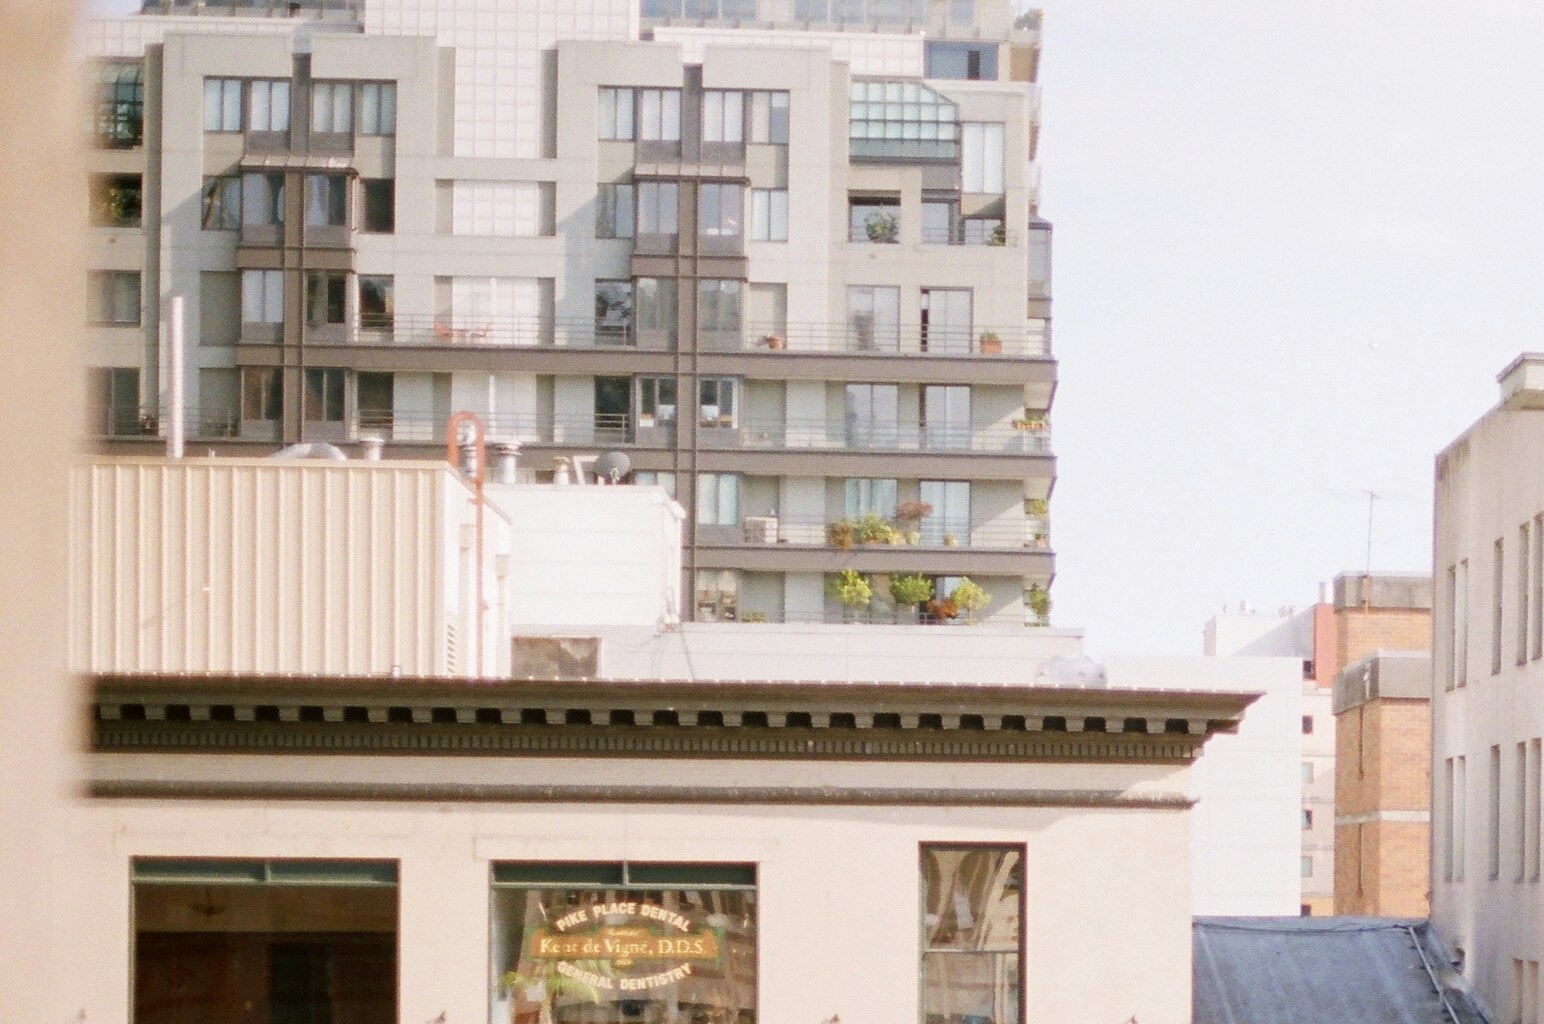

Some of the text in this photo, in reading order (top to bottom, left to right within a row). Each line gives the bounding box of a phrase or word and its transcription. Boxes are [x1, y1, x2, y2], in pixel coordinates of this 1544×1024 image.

[557, 901, 691, 933] PIKE PLACE DENTAL
[557, 961, 692, 991] GENERAL DENTISTRY
